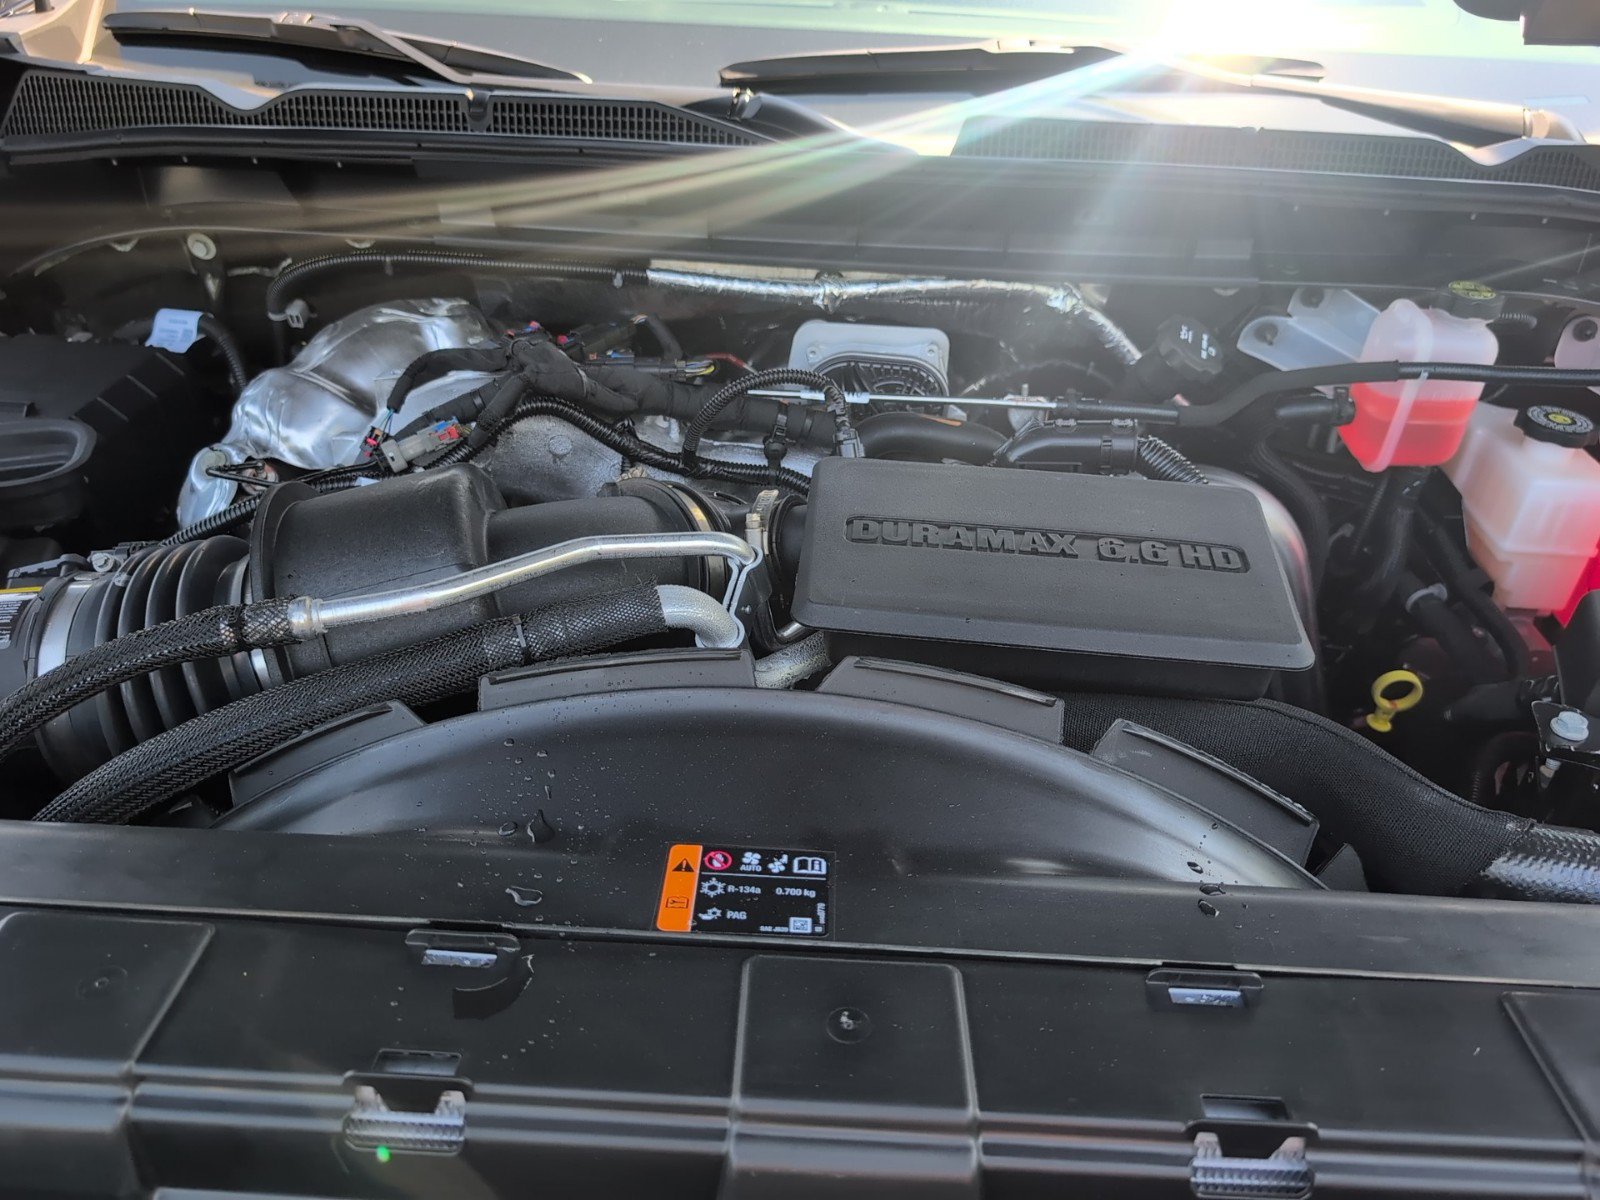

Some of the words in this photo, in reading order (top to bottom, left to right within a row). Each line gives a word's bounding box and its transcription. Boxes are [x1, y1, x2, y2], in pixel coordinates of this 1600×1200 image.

[851, 518, 1079, 558] DURAMAX
[1096, 537, 1170, 564] 6.6
[1177, 544, 1243, 571] HD
[740, 864, 762, 872] AUTO
[727, 884, 762, 894] R-134a
[775, 887, 802, 896] 0.700
[803, 888, 816, 898] kg
[726, 911, 747, 920] PAG
